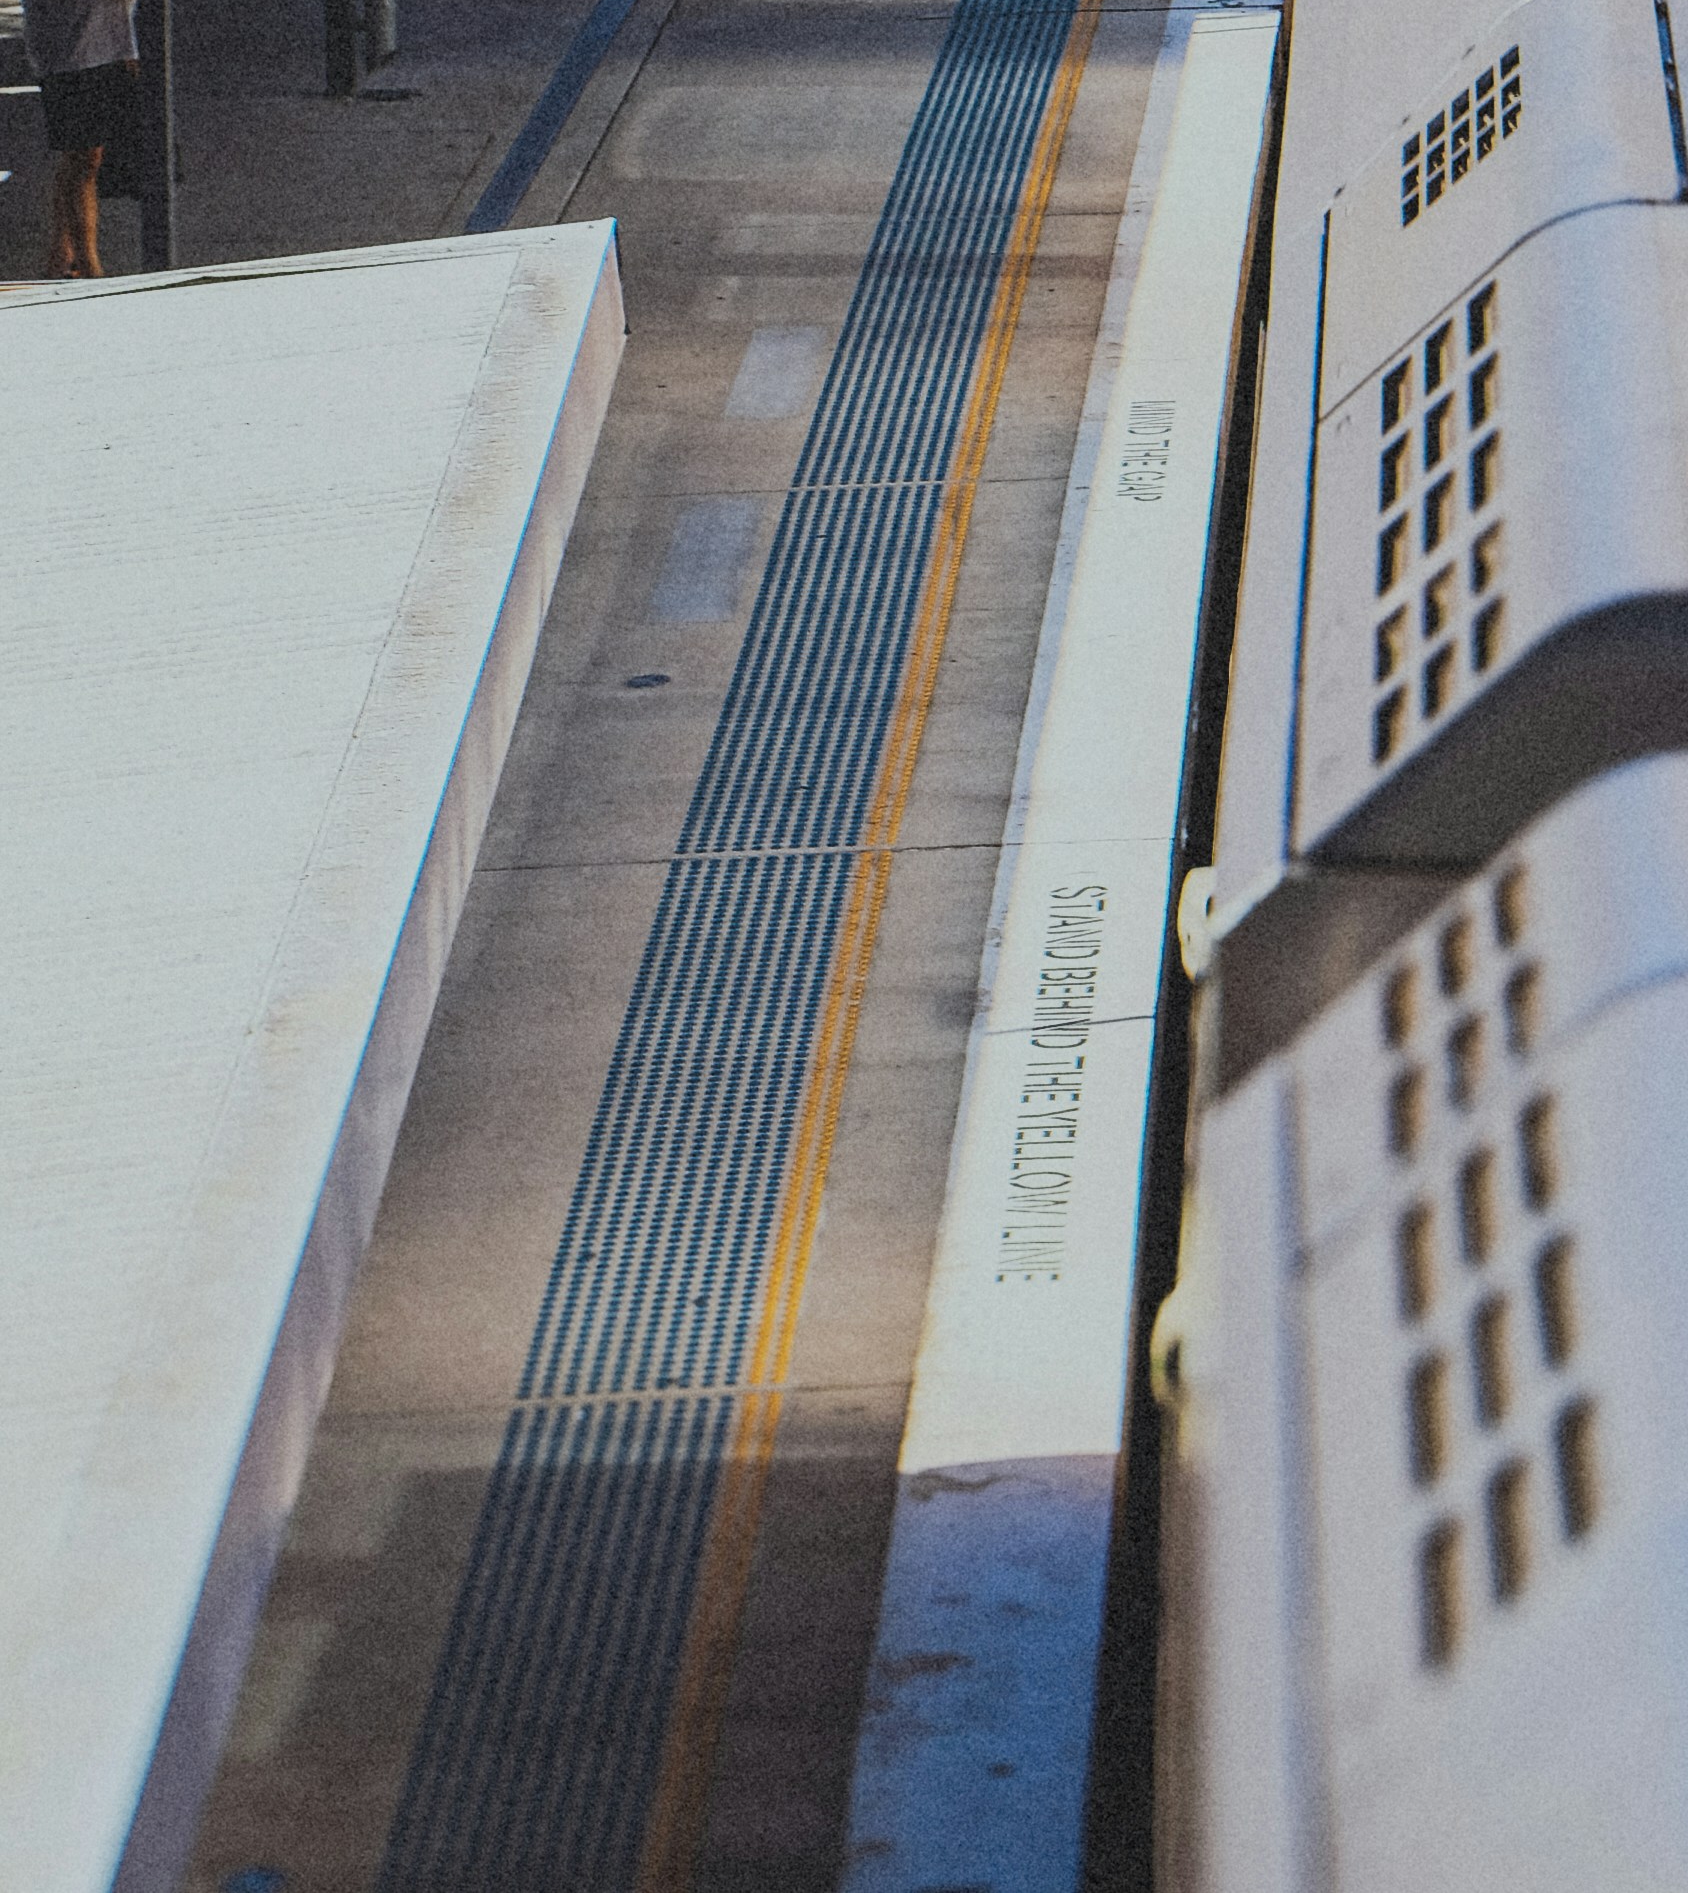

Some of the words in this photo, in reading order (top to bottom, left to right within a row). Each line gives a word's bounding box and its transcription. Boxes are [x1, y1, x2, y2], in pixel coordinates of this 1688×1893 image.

[1127, 400, 1176, 435] MIND
[1121, 439, 1170, 467] THE
[1115, 470, 1166, 502] GAP
[1043, 886, 1108, 959] STAND
[1030, 967, 1097, 1049] BEHIND
[1020, 1056, 1085, 1104] THE
[1005, 1107, 1079, 1215] YELLOW
[995, 1225, 1066, 1283] LINE
